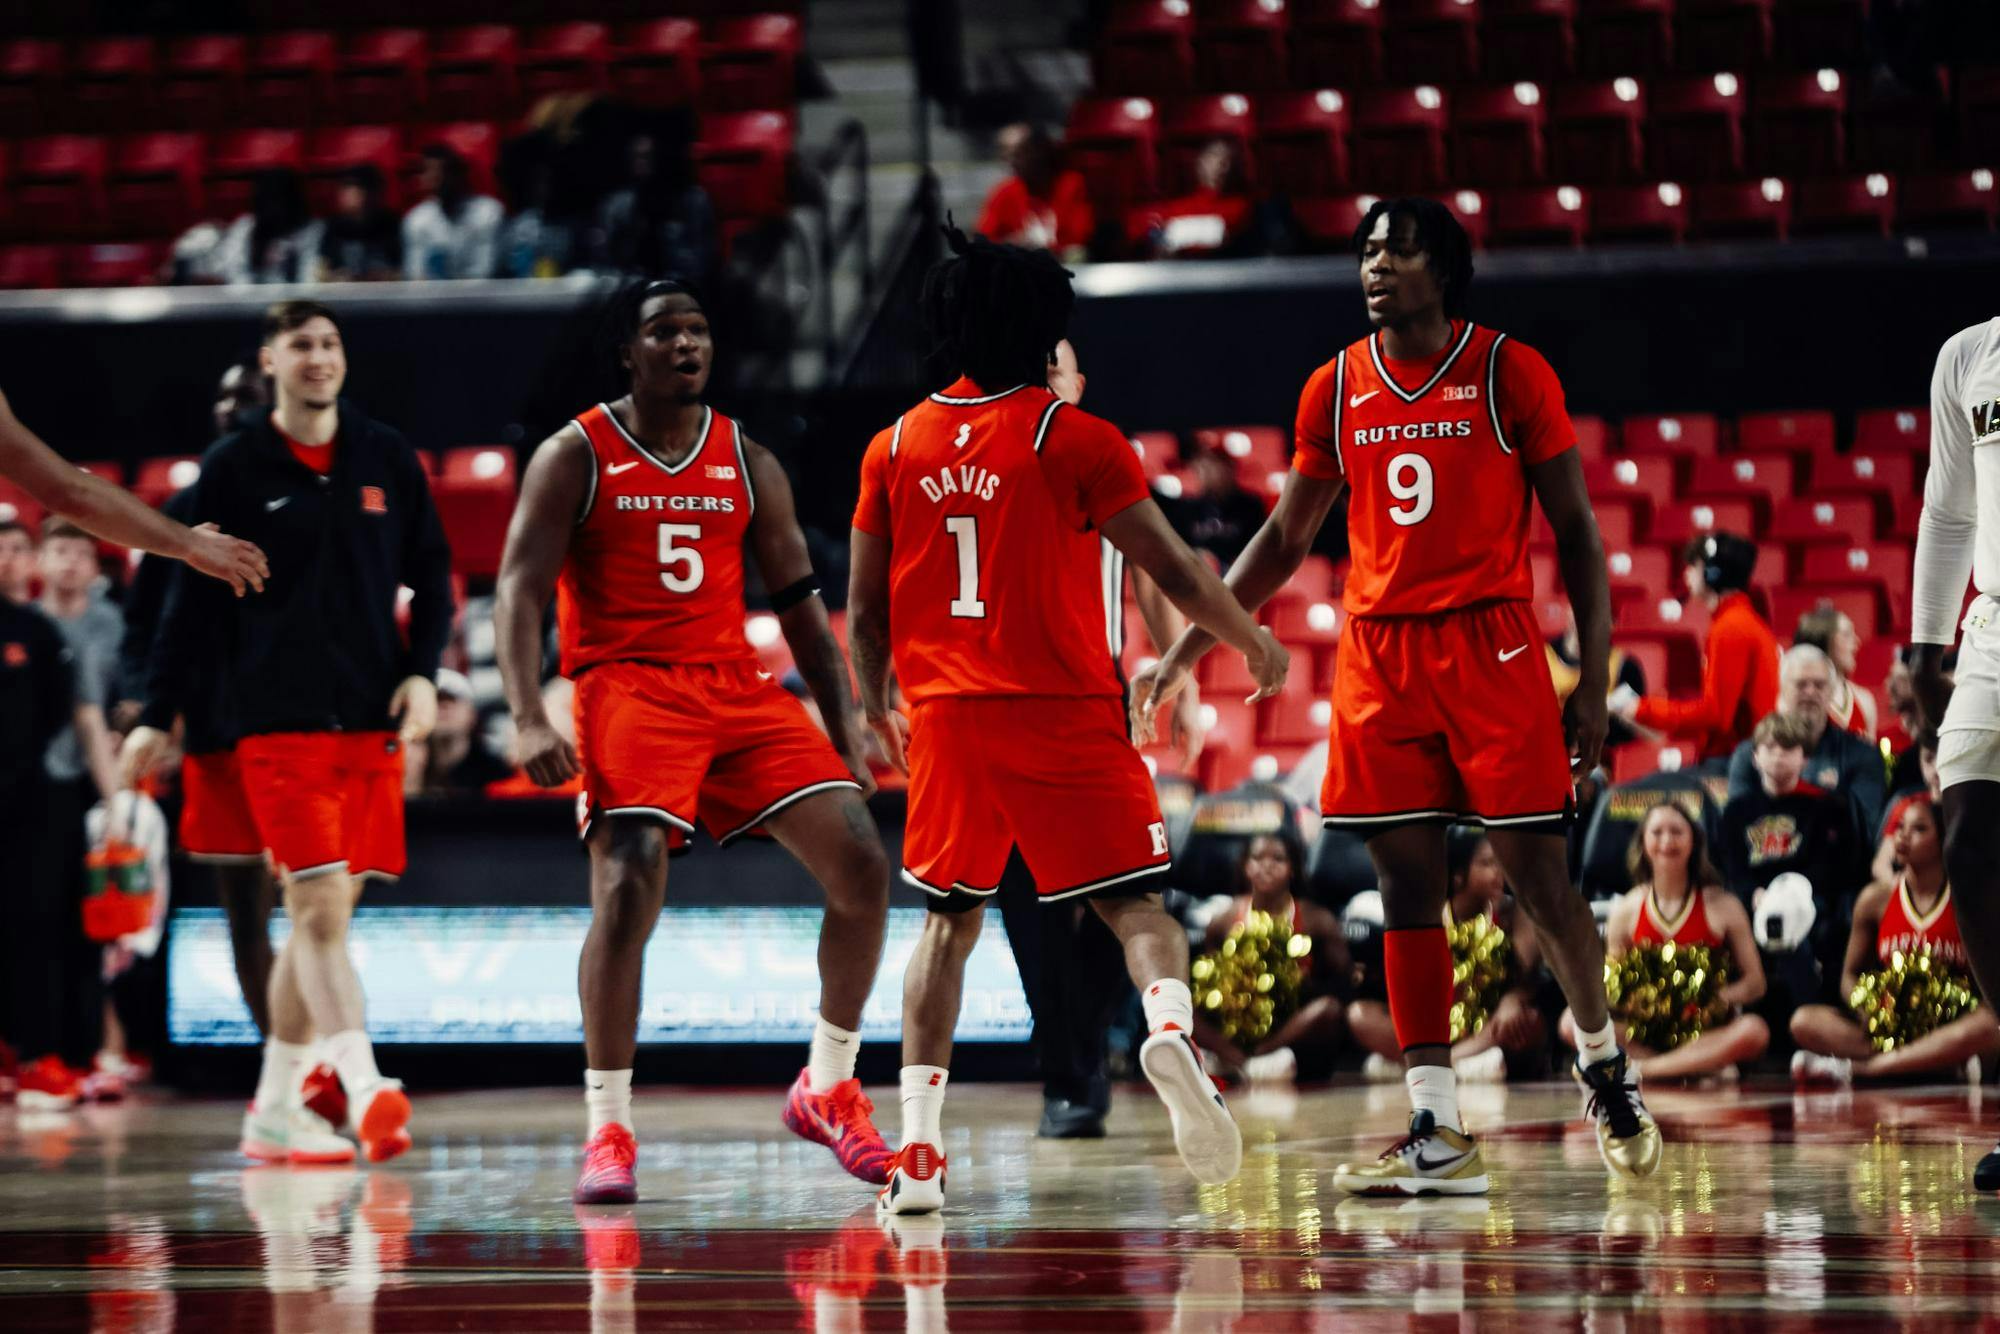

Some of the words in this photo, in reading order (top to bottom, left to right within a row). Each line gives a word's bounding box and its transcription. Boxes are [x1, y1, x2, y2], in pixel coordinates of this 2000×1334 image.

[1354, 420, 1472, 446] RUTGERS
[616, 495, 735, 513] RUTGERS
[919, 464, 1001, 504] DAVIS
[1387, 452, 1434, 527] 9
[657, 522, 705, 594] 5
[945, 515, 986, 619] 1
[1147, 821, 1169, 856] R
